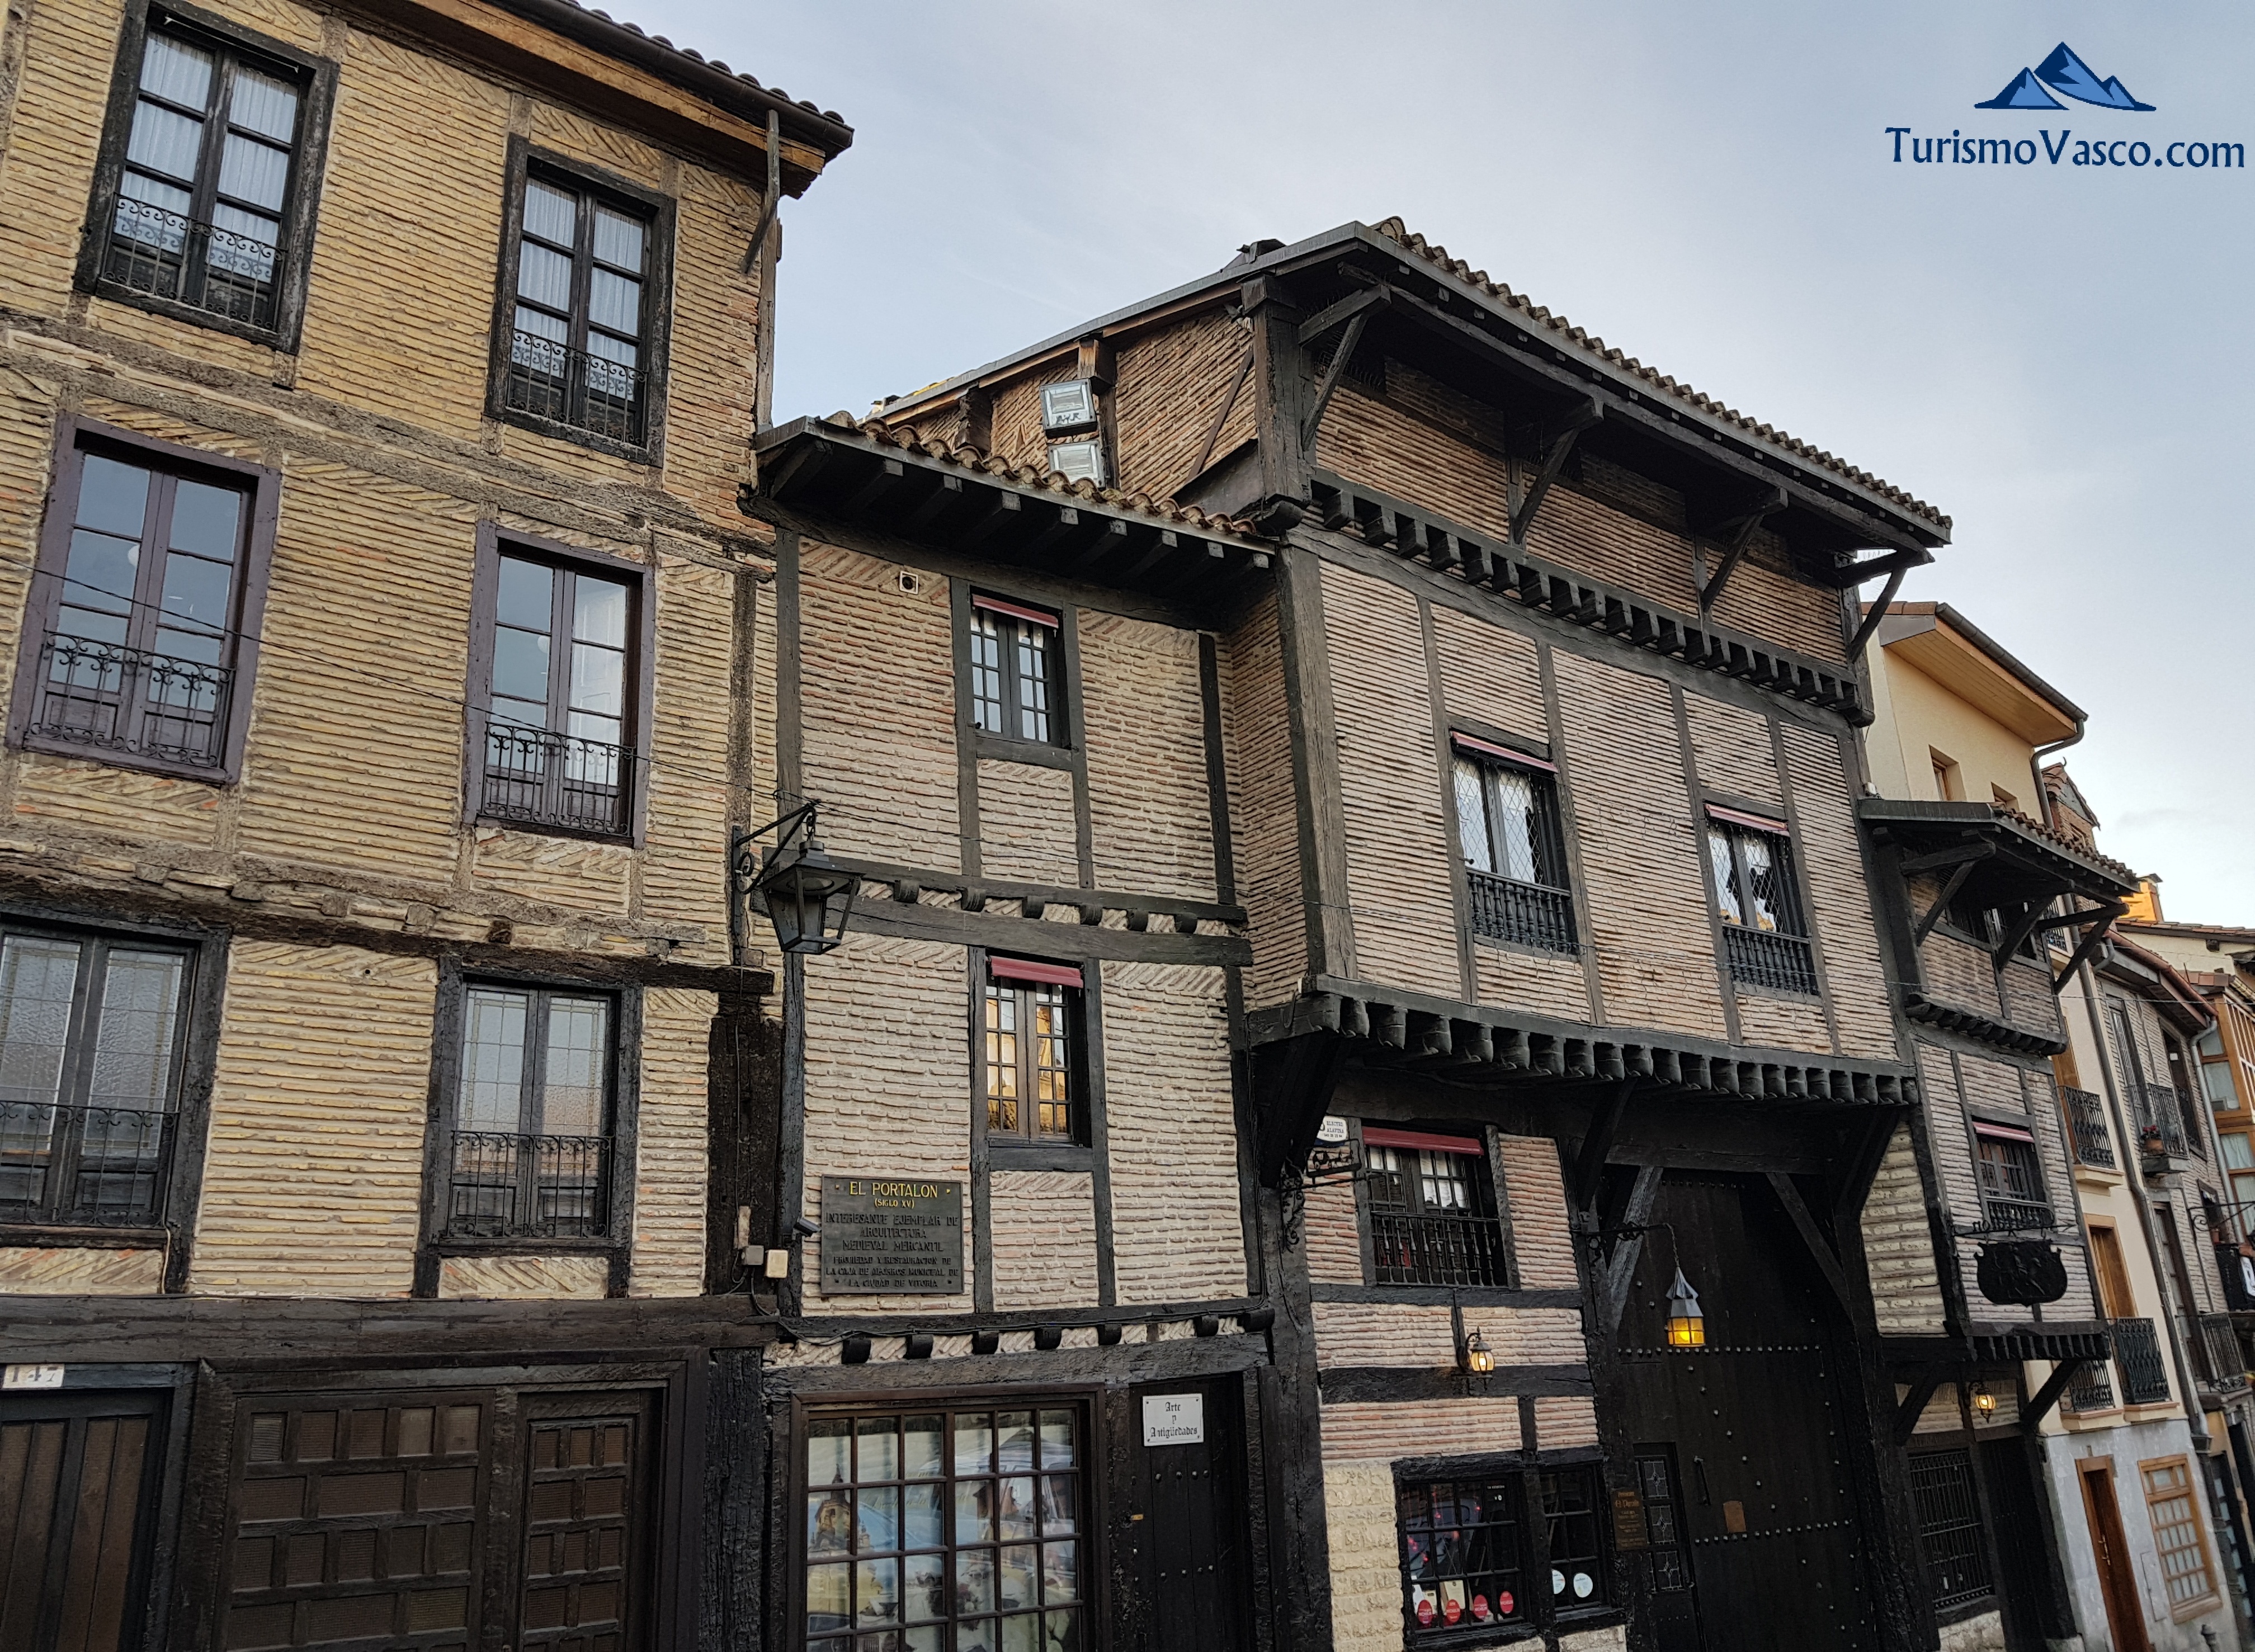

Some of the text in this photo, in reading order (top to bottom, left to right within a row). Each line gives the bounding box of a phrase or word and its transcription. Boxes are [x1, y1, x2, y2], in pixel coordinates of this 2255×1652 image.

[850, 1181, 938, 1198] EL PORTALON
[875, 1198, 915, 1209] (SIGLO XV)
[826, 1212, 959, 1226] INTERESANTE EJEMPLAR DE
[860, 1227, 926, 1238] ARQUITECTURA
[843, 1239, 943, 1252] MEDIEVAL MERCANTIL
[871, 1267, 906, 1276] AHORROS
[909, 1268, 945, 1276] MUNICIPAL
[848, 1278, 860, 1287] LA
[863, 1278, 890, 1287] CIUDAD
[908, 1279, 938, 1287] VITORIA
[12, 1366, 59, 1382] 147
[1165, 1401, 1181, 1412] Arte
[1150, 1426, 1198, 1439] Antigüedades
